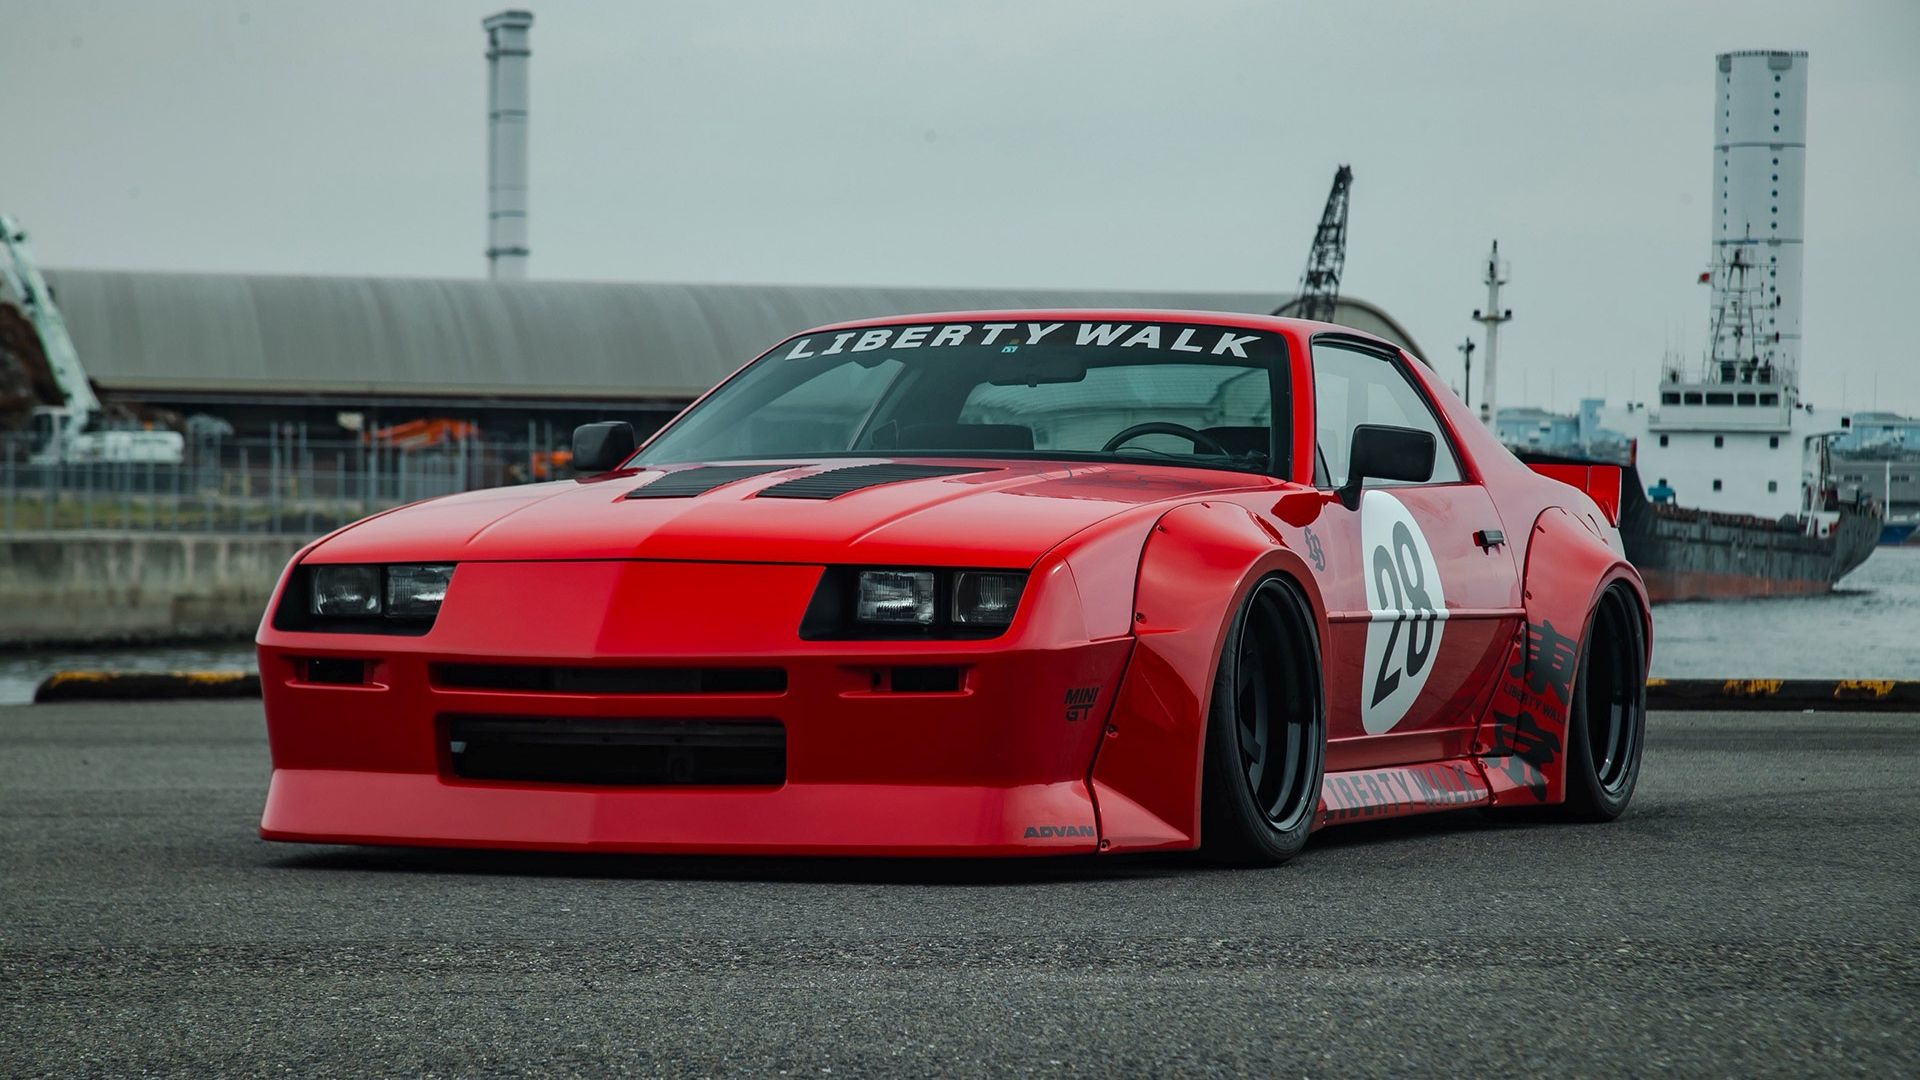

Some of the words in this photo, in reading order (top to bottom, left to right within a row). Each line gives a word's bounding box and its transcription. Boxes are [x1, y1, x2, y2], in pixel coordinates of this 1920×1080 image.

[784, 323, 1065, 361] LIBERTY
[1075, 323, 1262, 358] WALK
[1371, 520, 1437, 710] 28
[1063, 687, 1099, 705] MINI
[1065, 703, 1095, 721] GT
[1024, 826, 1095, 838] ADVAN
